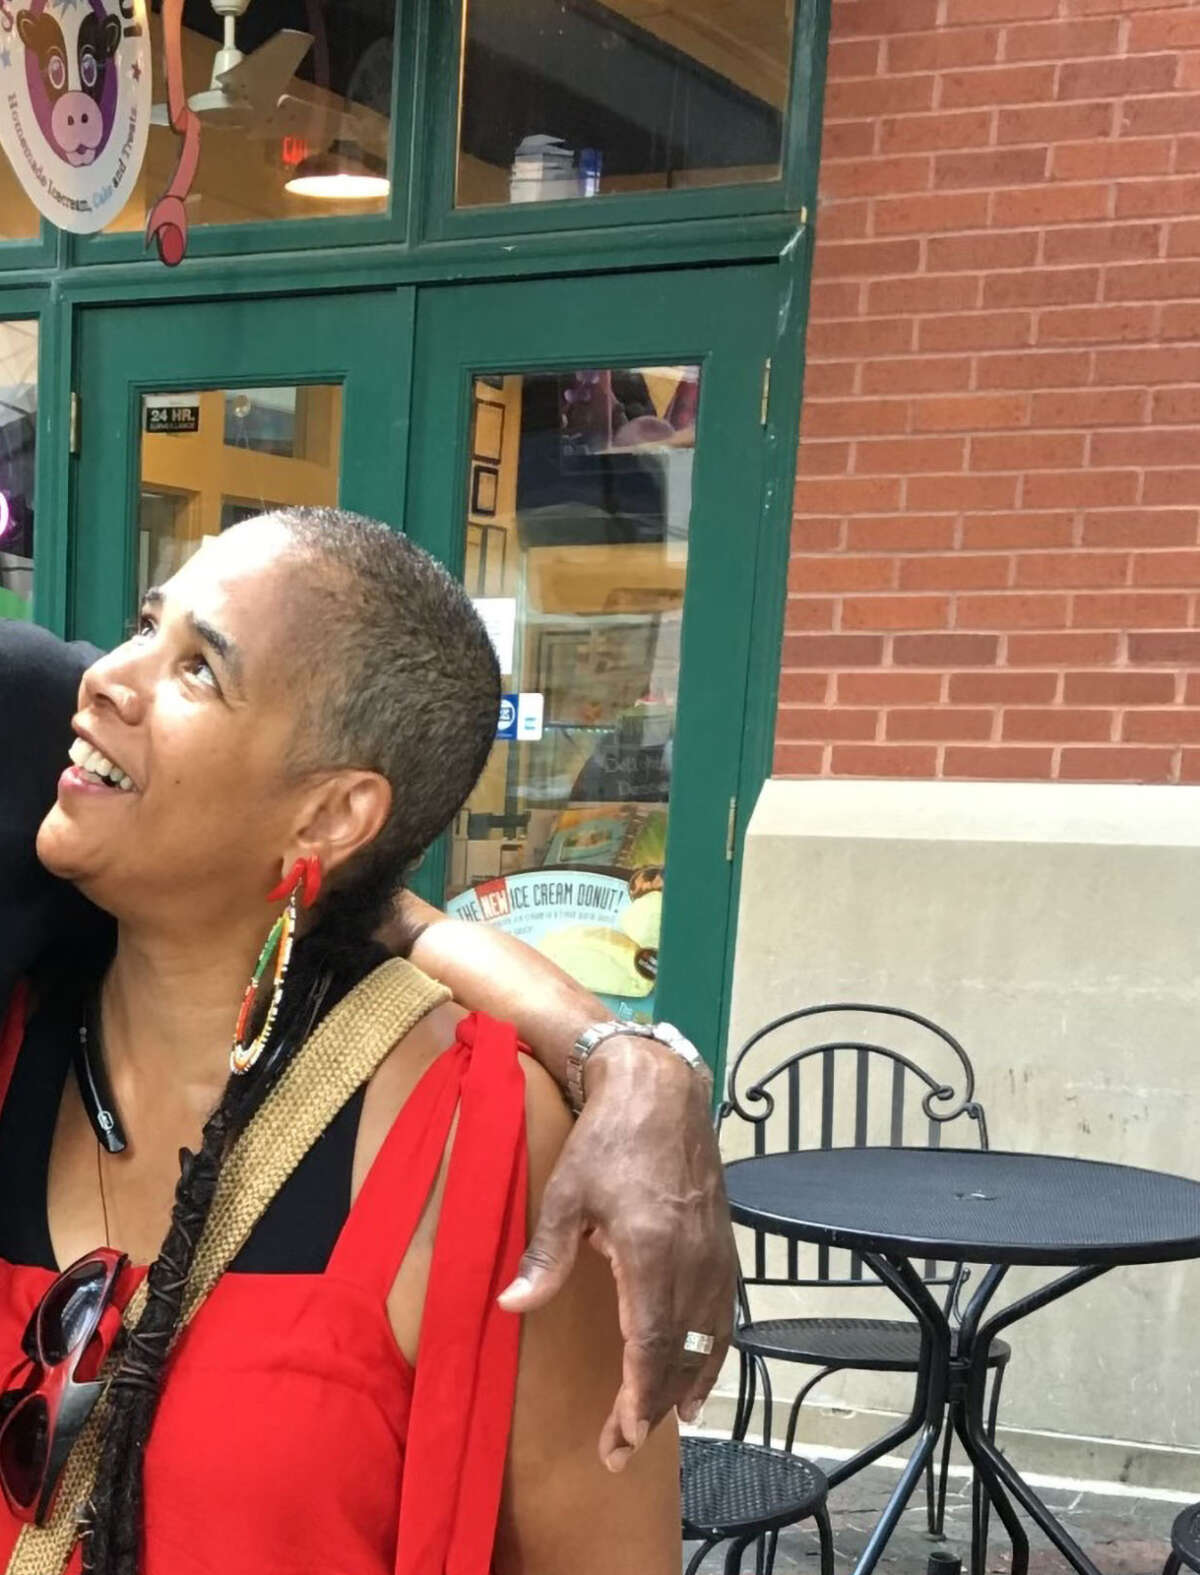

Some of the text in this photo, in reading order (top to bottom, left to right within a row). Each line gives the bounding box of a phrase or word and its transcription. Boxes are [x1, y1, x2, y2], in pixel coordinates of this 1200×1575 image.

[151, 408, 196, 422] 24 HR.
[456, 901, 481, 922] THE
[480, 890, 510, 920] NEW
[510, 885, 531, 909] ICE
[532, 882, 574, 907] CREAM
[577, 883, 624, 914] DONUT!
